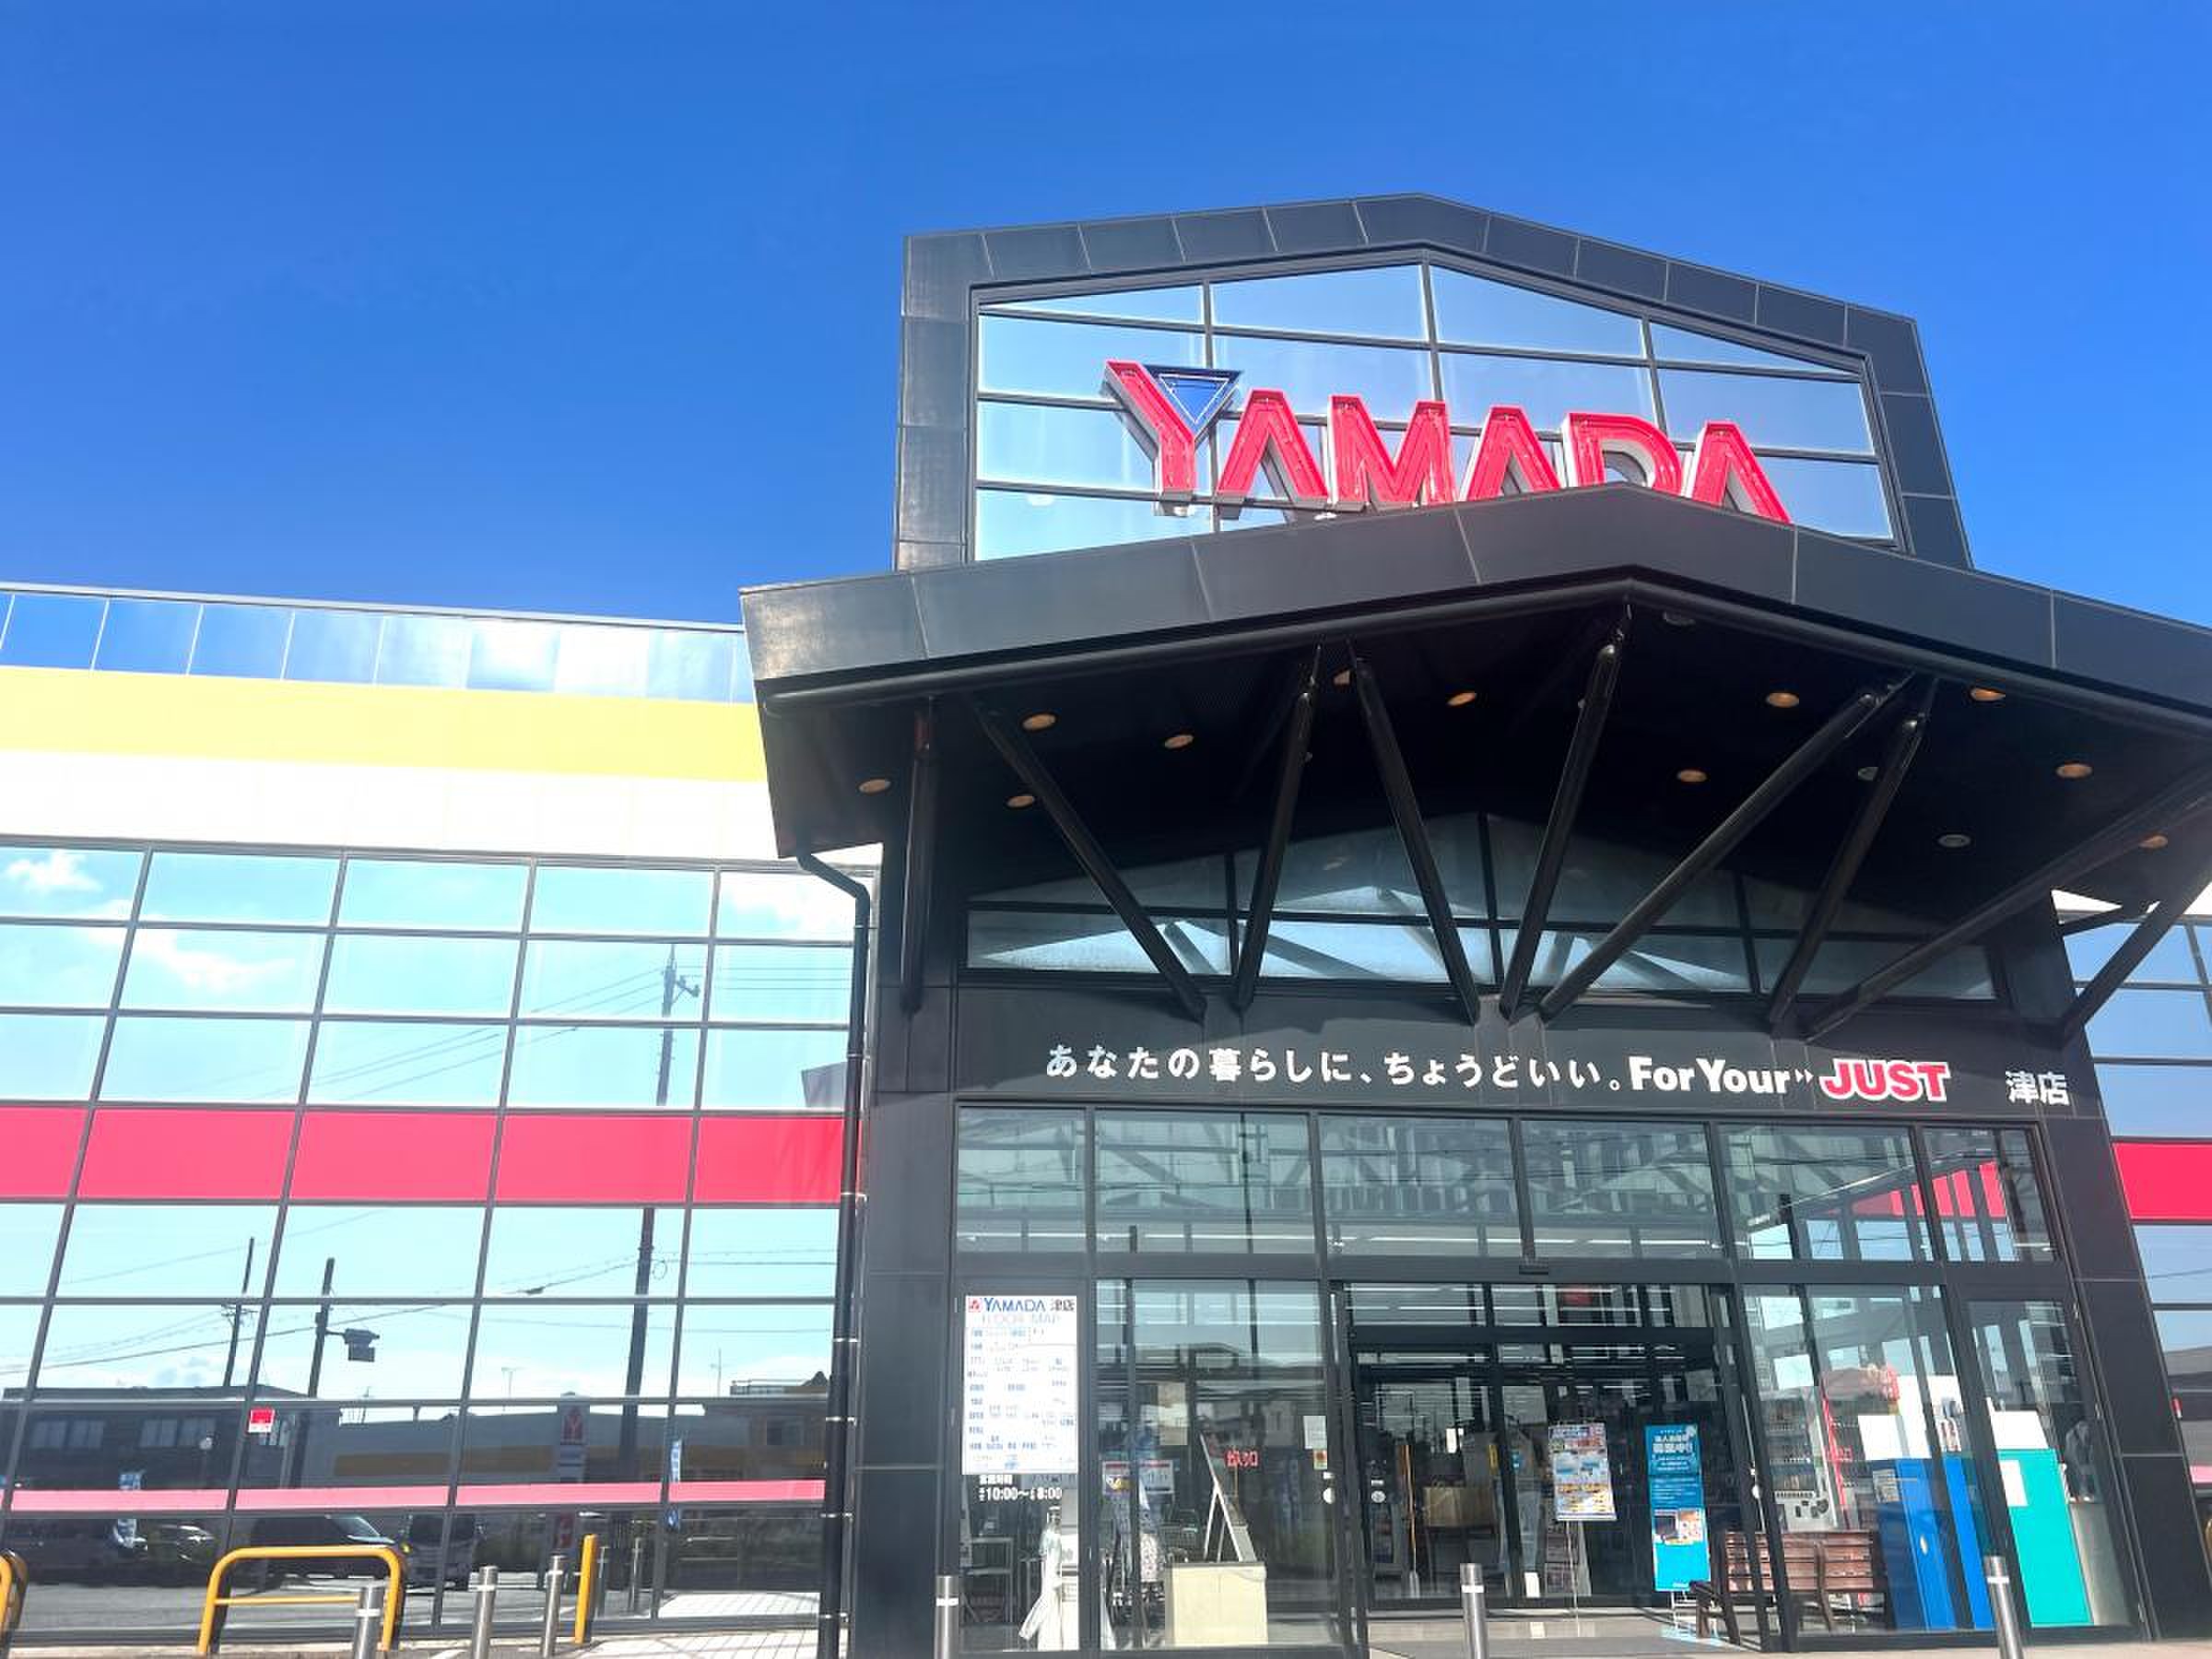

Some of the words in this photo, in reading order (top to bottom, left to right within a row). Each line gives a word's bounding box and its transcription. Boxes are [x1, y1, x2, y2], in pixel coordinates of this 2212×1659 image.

[1105, 359, 1792, 524] YAMADA
[1047, 1045, 1620, 1090] あなたの暮らしに、ちょうどいい。
[1629, 1056, 1694, 1090] For
[1696, 1059, 1790, 1093] Your
[1819, 1058, 1950, 1100] JUST
[2005, 1070, 2069, 1105] 津店
[983, 1298, 1046, 1312] YAMADA
